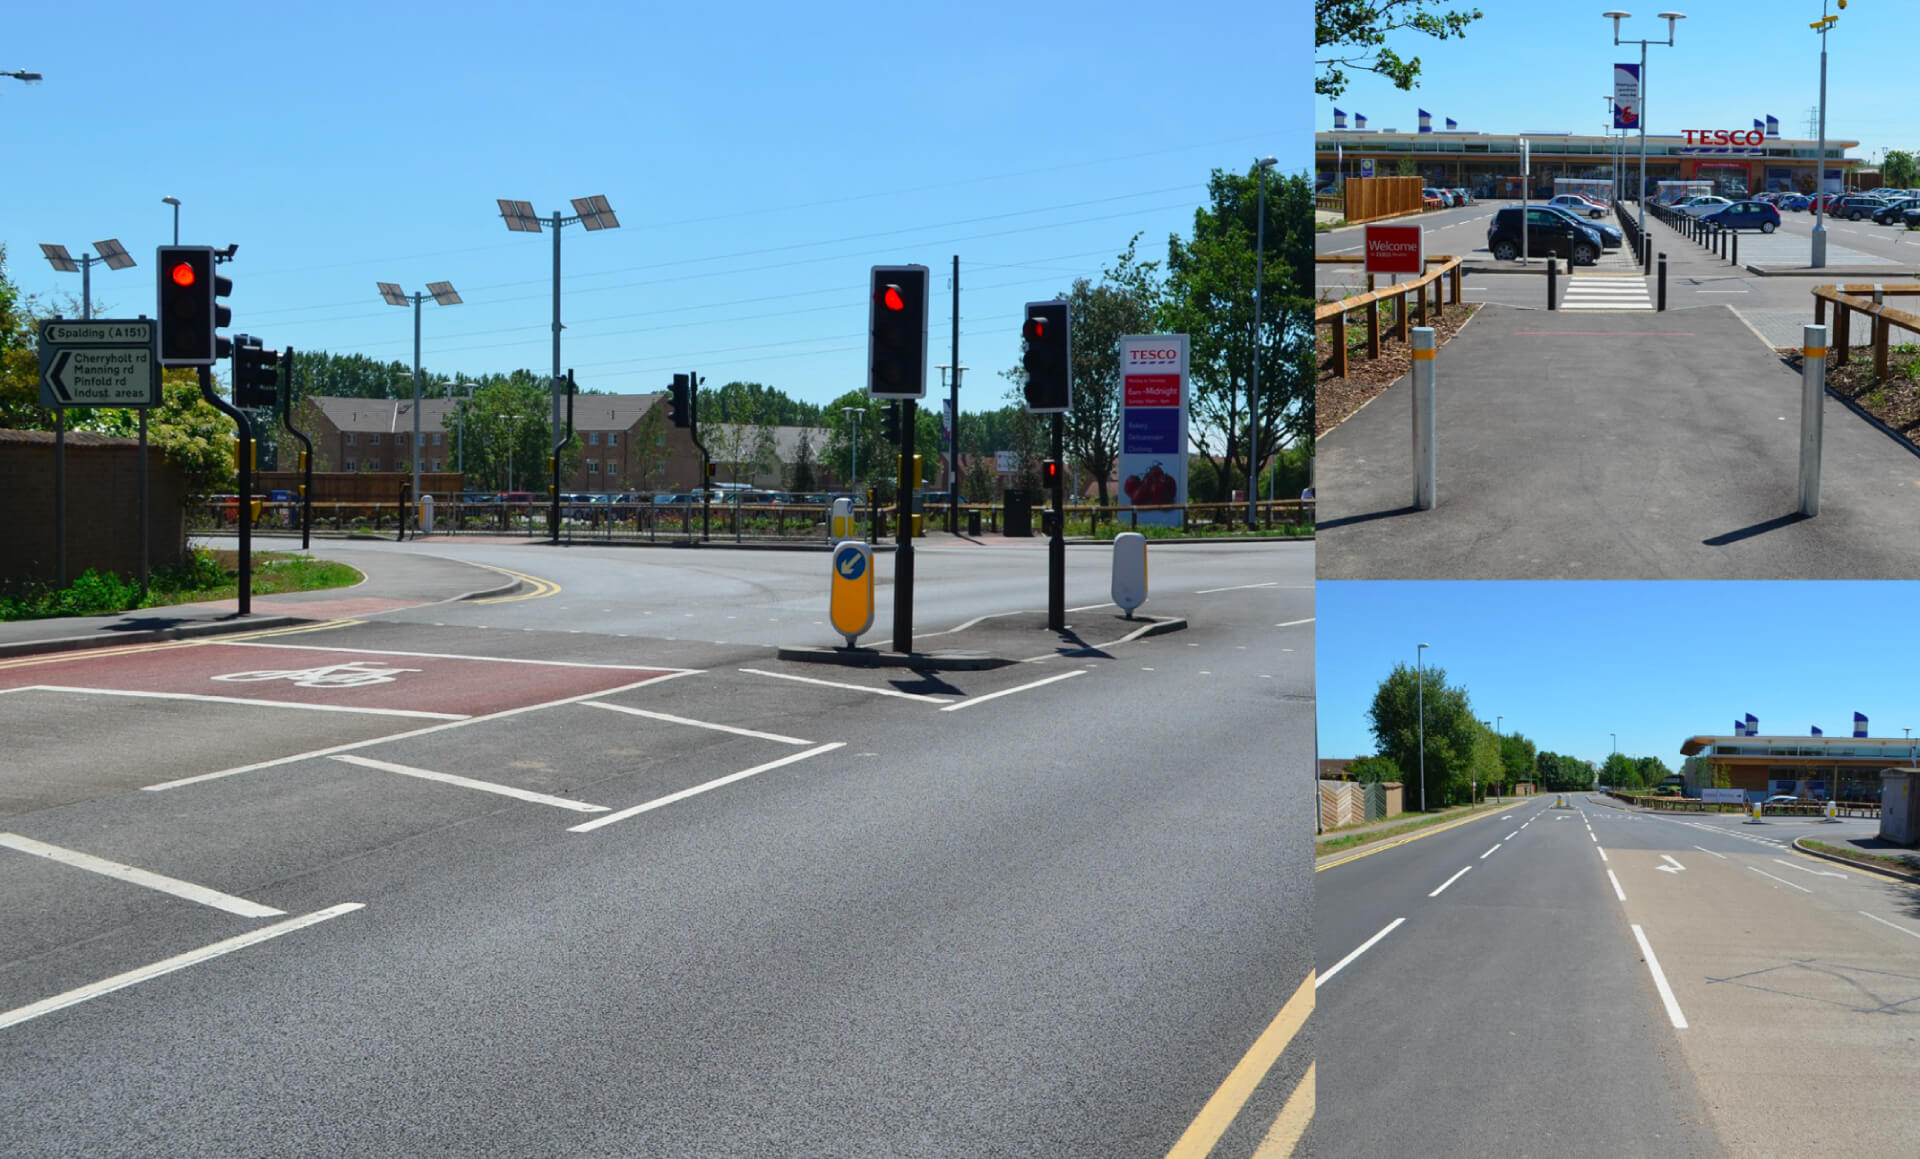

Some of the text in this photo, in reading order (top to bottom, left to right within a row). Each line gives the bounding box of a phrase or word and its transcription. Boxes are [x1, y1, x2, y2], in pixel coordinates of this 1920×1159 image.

[1681, 129, 1764, 146] TESCO
[1369, 240, 1417, 252] Welcome
[58, 327, 147, 339] Spalding (A151)
[74, 353, 147, 365] Cherryholt rd
[1129, 349, 1177, 360] TESCO
[74, 365, 134, 375] Manning rd
[74, 376, 127, 386] Pinfold rd
[115, 390, 144, 398] areas
